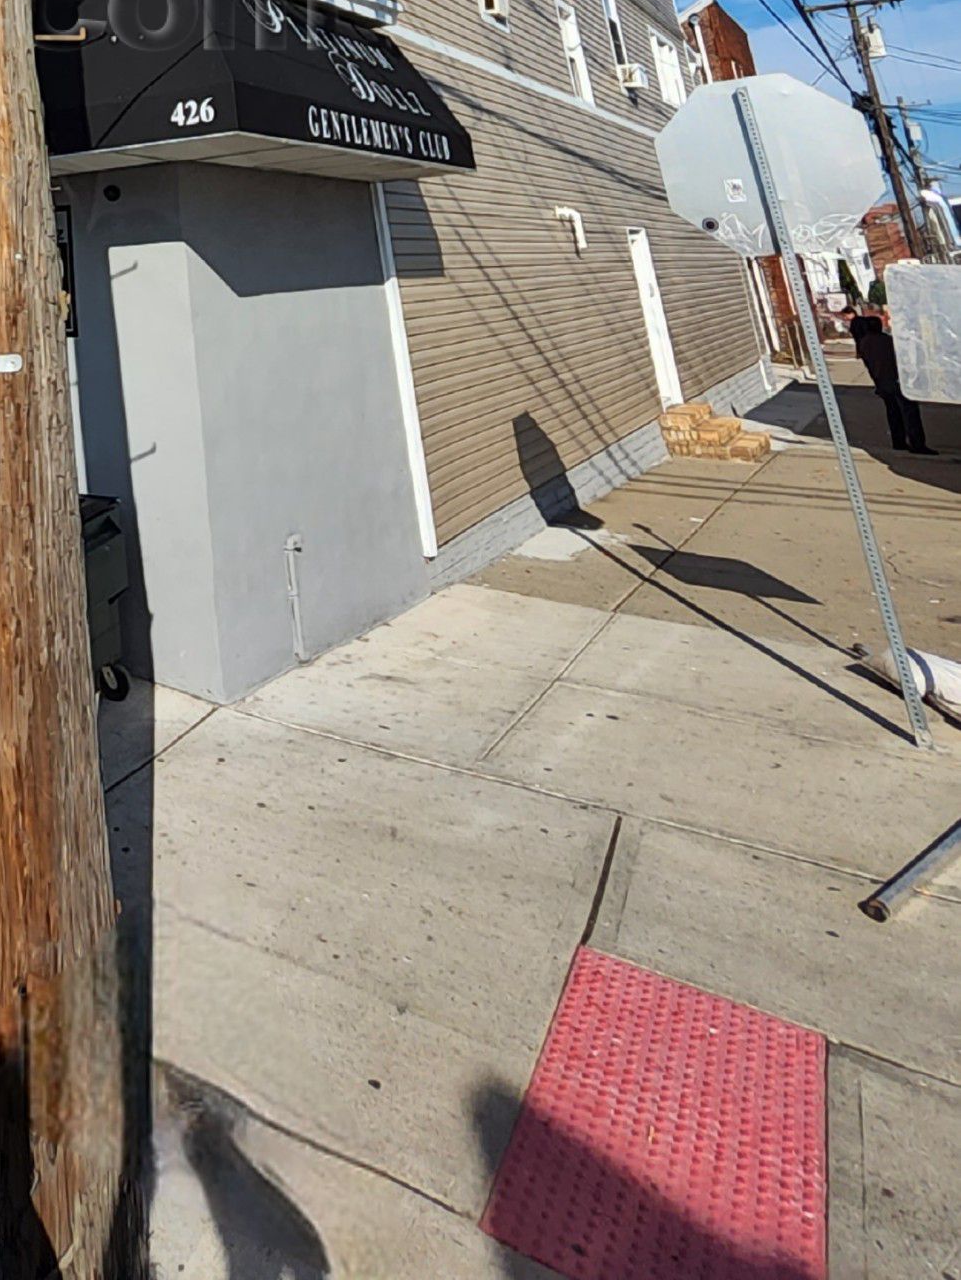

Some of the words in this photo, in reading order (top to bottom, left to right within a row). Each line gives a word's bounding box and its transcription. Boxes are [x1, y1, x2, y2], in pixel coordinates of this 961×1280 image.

[170, 96, 215, 127] 426
[329, 53, 432, 118] DOLLZ
[307, 105, 414, 157] GENTLEMEN'S
[418, 131, 451, 162] CLUB
